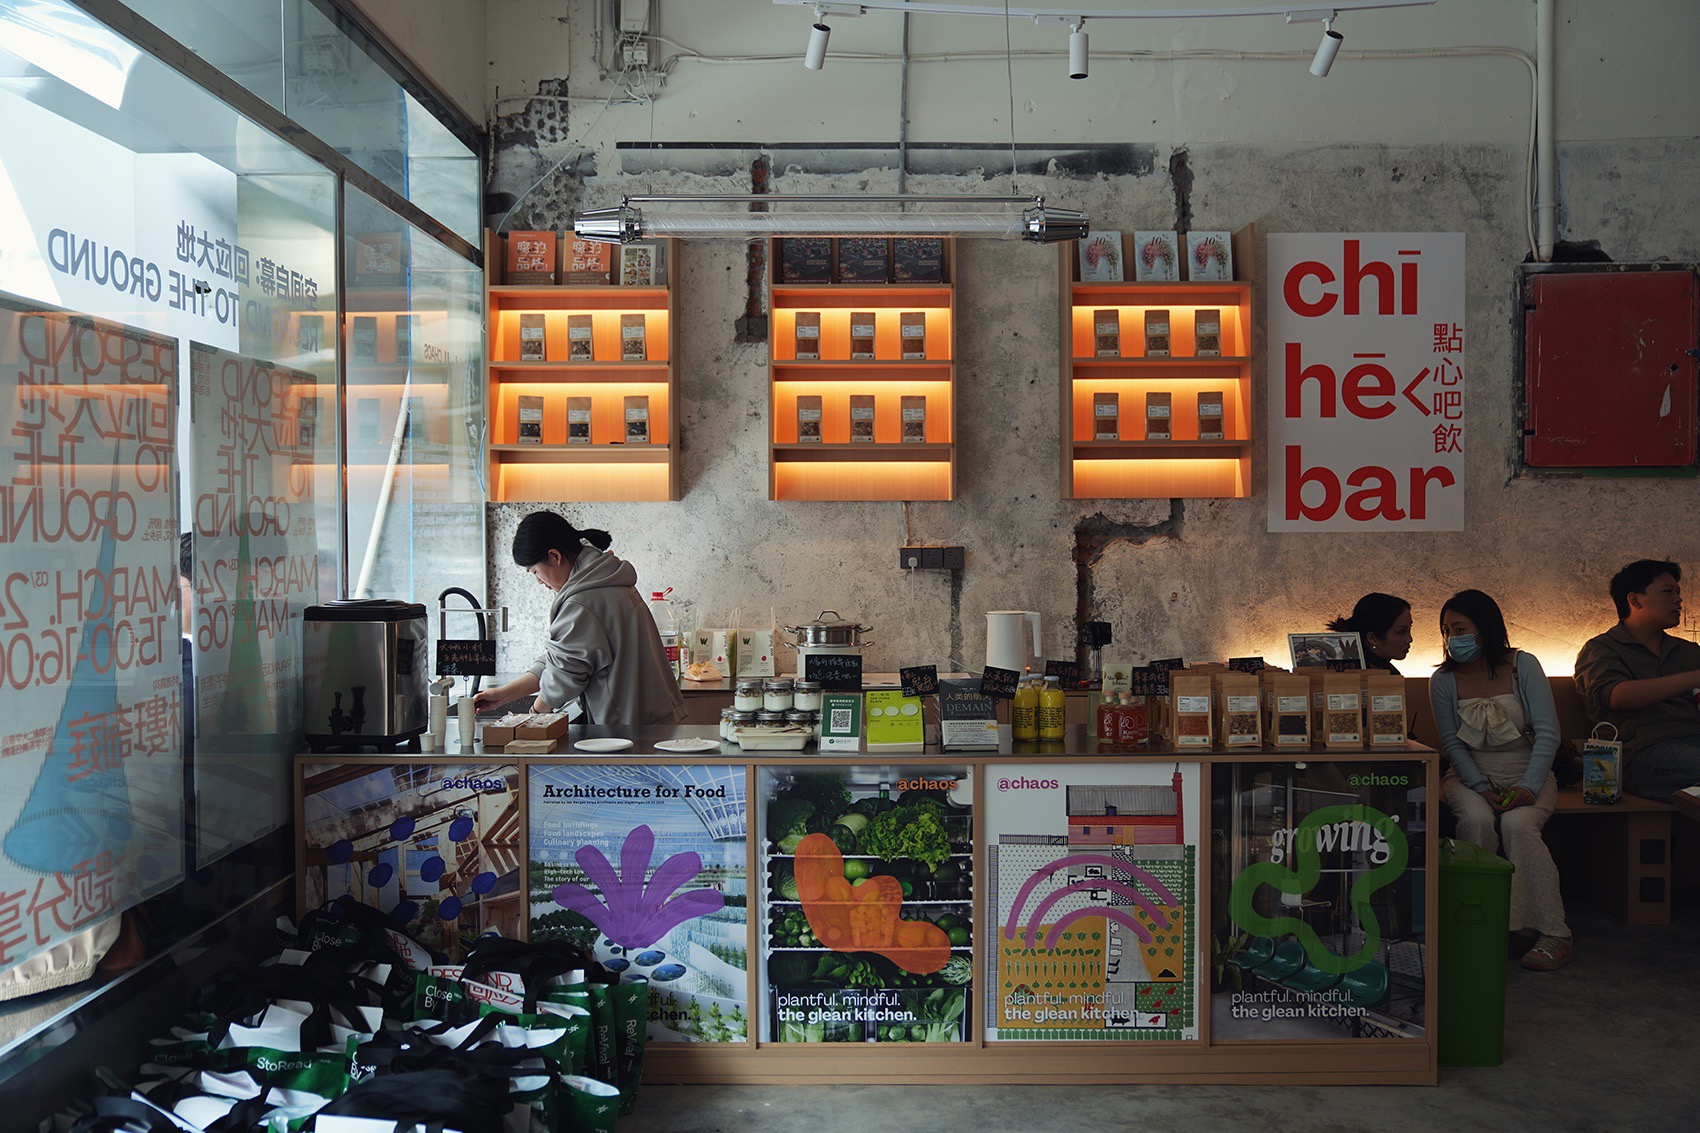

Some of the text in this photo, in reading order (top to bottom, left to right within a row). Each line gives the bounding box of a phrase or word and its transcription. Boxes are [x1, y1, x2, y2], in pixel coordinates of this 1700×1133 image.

[1283, 240, 1422, 318] chī
[1285, 342, 1397, 420] hē
[1432, 323, 1463, 454] 點心吧飲
[1285, 445, 1456, 522] bar
[946, 703, 993, 713] DEMAIN
[441, 776, 503, 792] @chaos
[896, 777, 958, 792] @chaos
[997, 777, 1059, 792] @chaos
[1348, 773, 1409, 789] @chaos
[543, 784, 726, 798] Architecture for Food
[543, 821, 598, 831] Food buildings
[563, 829, 604, 839] landscapes
[1269, 807, 1400, 865] growing
[314, 931, 342, 948] Close
[425, 985, 452, 1002] Close
[646, 991, 676, 1007] dful.
[778, 993, 901, 1010] plantful. mindful.
[1004, 991, 1127, 1008] plantful. mindful.
[1231, 990, 1354, 1005] plantful. mindful.
[424, 996, 437, 1012] By
[778, 1008, 917, 1024] the glean kitchen.
[1004, 1007, 1143, 1023] the glean kitchen.
[1231, 1005, 1370, 1022] the glean kitchen.
[256, 1057, 312, 1072] StoRead
